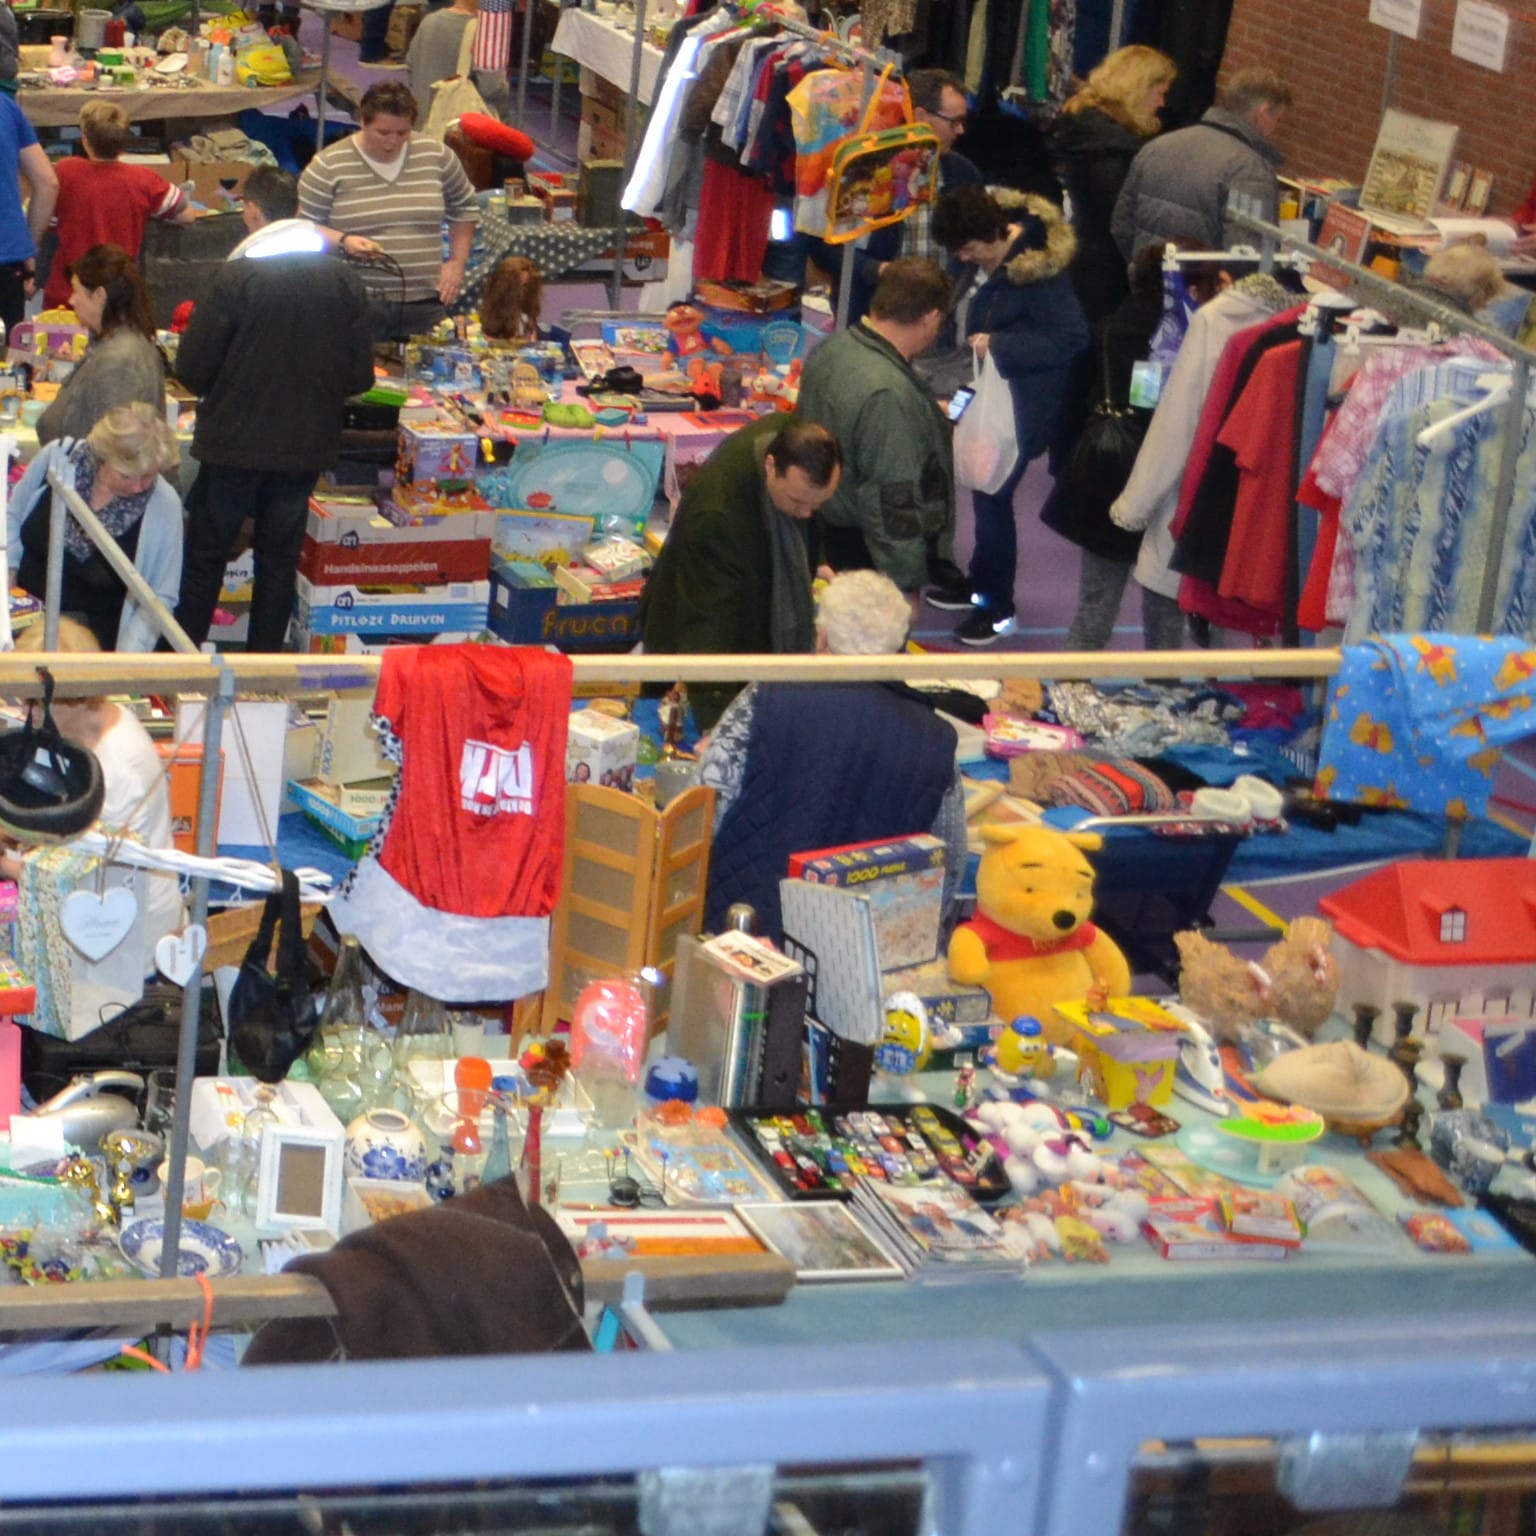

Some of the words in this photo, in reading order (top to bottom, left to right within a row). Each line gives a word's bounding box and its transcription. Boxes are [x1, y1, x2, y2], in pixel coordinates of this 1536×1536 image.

[323, 560, 438, 575] Handsinaasappelen
[390, 613, 446, 626] DRUIVEN
[847, 866, 880, 883] 1000
